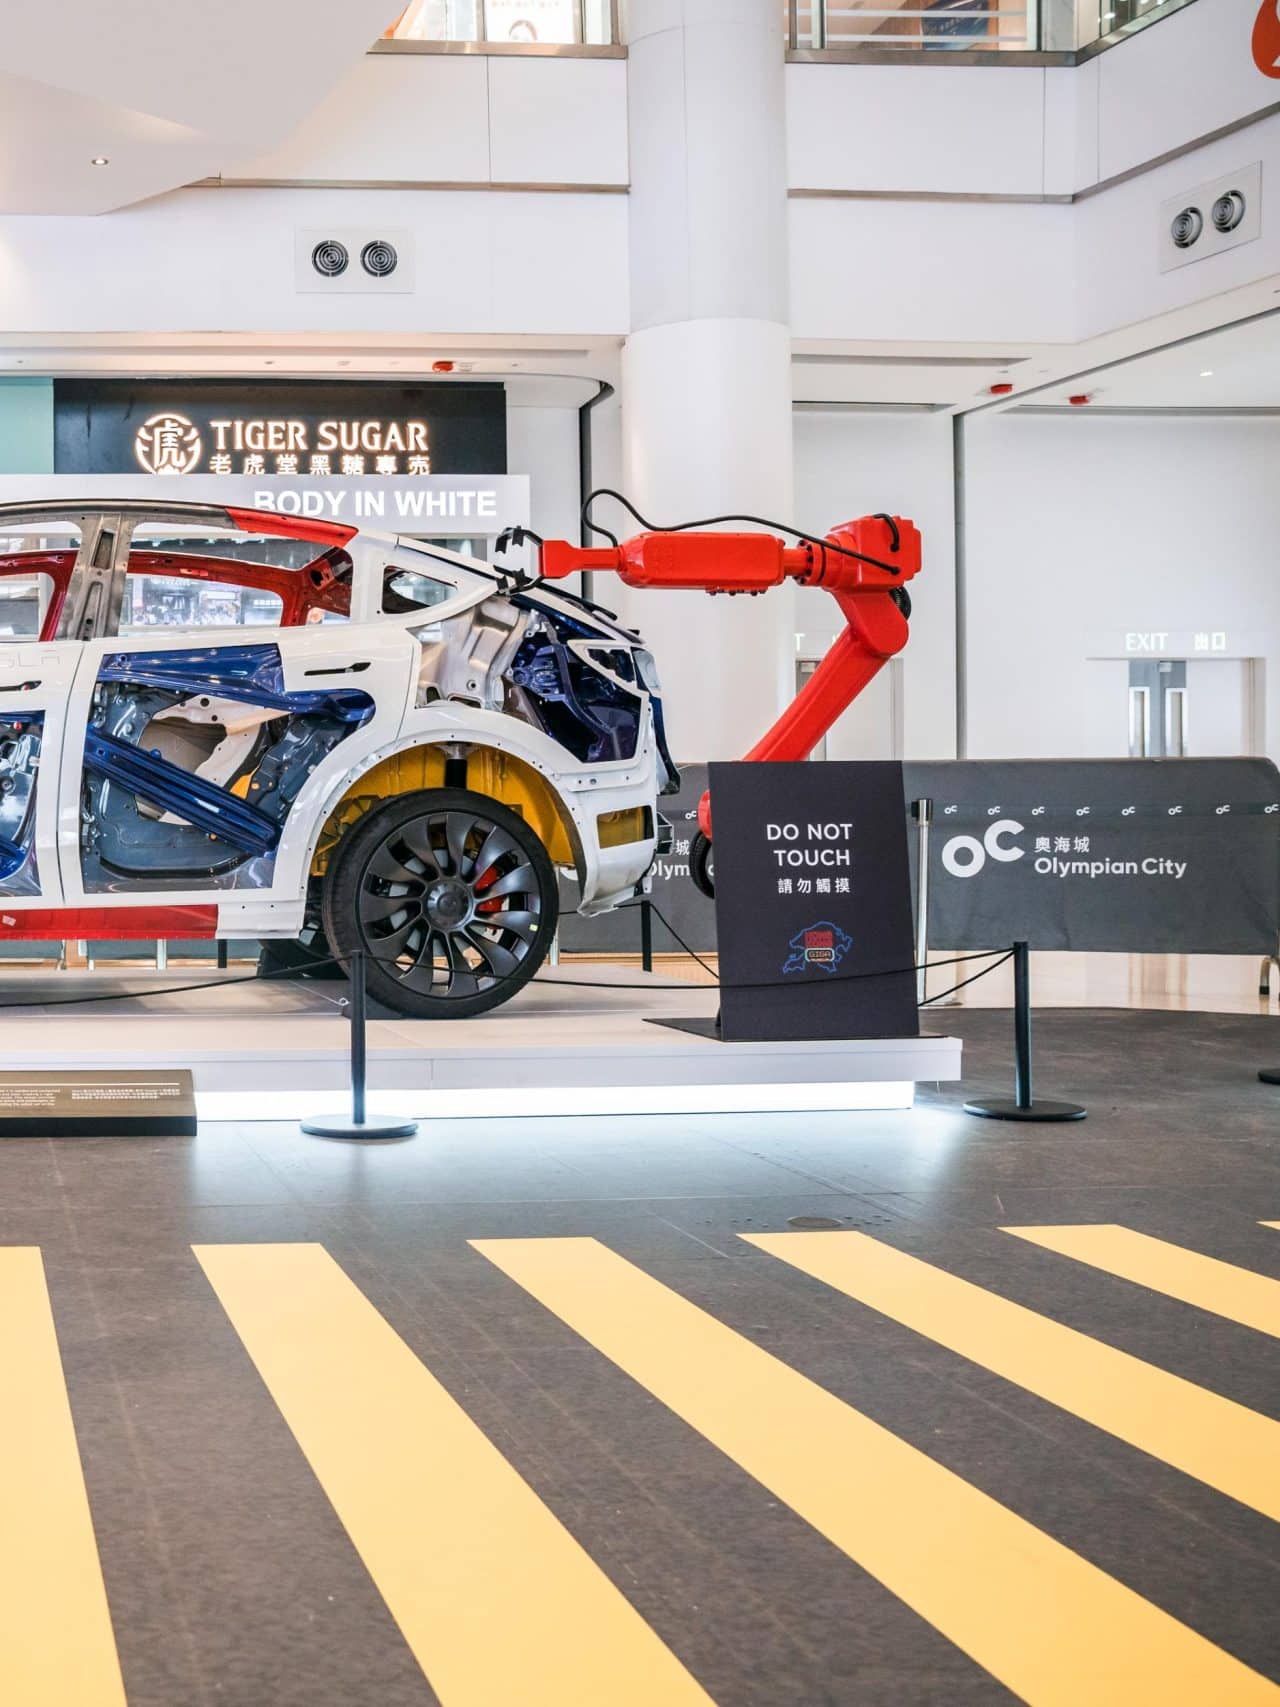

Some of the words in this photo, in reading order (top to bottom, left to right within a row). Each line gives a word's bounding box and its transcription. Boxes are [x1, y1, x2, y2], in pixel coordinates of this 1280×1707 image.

[210, 420, 308, 451] TIGER
[317, 420, 429, 452] SUGAR
[254, 490, 346, 516] BODY
[355, 490, 385, 516] IN
[394, 490, 497, 516] WHITE
[1125, 632, 1169, 652] EXIT
[1194, 632, 1227, 652] 出口
[766, 823, 799, 841] DO
[807, 823, 853, 841] NOT
[773, 849, 850, 866] TOUCH
[941, 819, 1025, 878] OC
[1034, 857, 1138, 879] Olympian
[1141, 857, 1187, 879] City
[778, 877, 851, 894] 請勿觸摸
